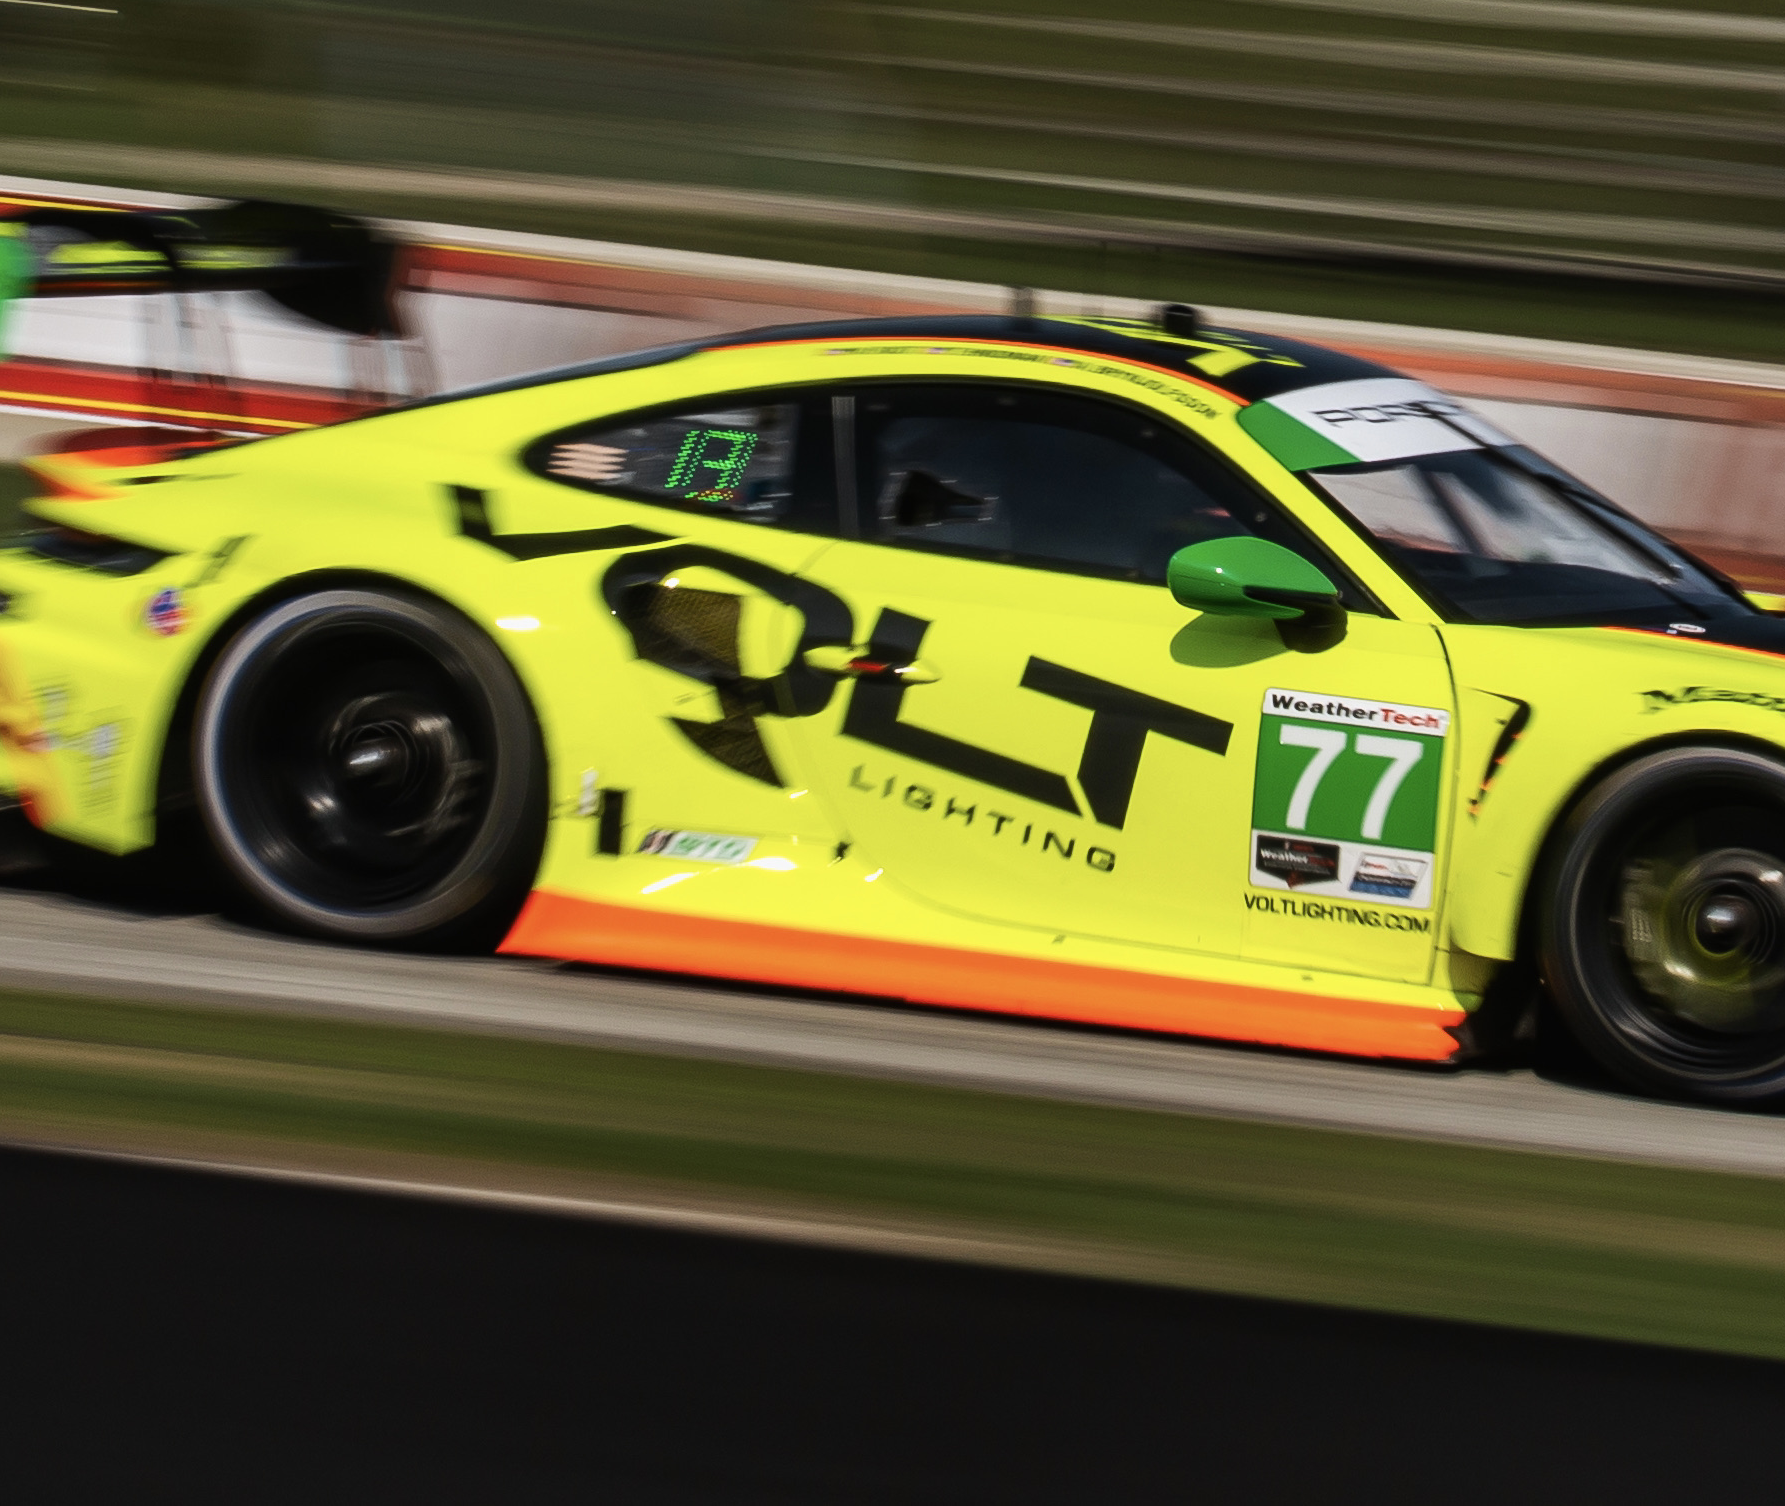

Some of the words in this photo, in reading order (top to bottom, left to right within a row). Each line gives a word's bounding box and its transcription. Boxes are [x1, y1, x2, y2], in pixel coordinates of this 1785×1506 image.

[439, 482, 1235, 832] VOLT
[1271, 693, 1441, 729] WeatherTech
[848, 762, 1118, 874] LIGHTING
[1279, 724, 1424, 840] 77
[1243, 891, 1431, 934] VOLTLIGHTING.COM
